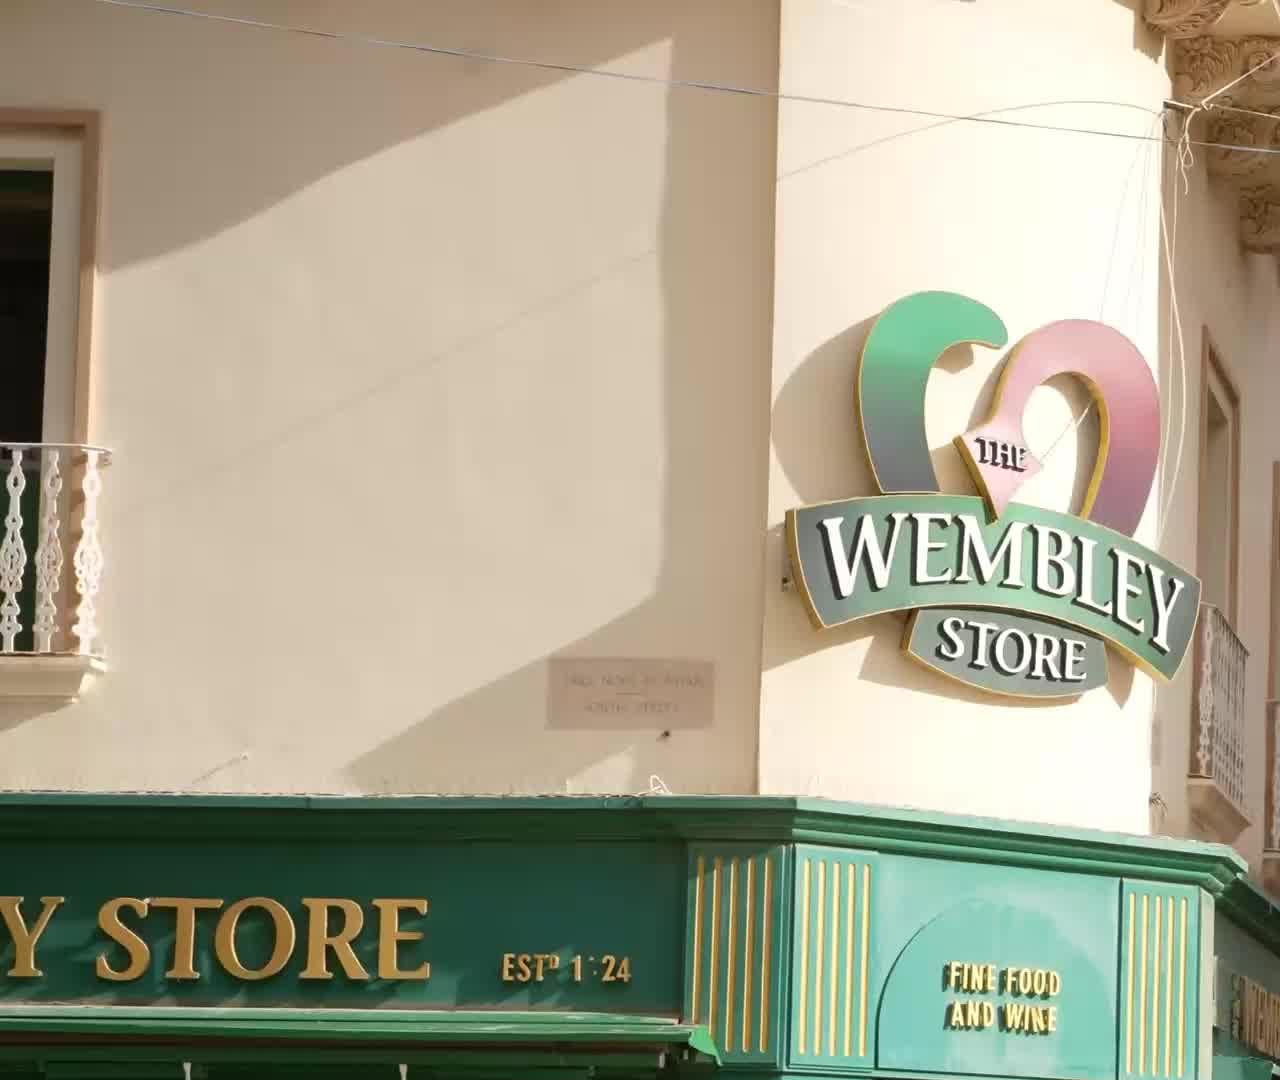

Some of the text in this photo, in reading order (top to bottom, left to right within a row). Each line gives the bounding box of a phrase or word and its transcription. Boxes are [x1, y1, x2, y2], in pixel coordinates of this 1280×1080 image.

[973, 436, 1027, 473] THE
[818, 511, 1184, 654] WEMBLEY
[936, 616, 1089, 683] STORE
[95, 896, 433, 983] STORE
[947, 960, 1061, 997] FINE FOOD
[950, 999, 1057, 1033] AND WINE
